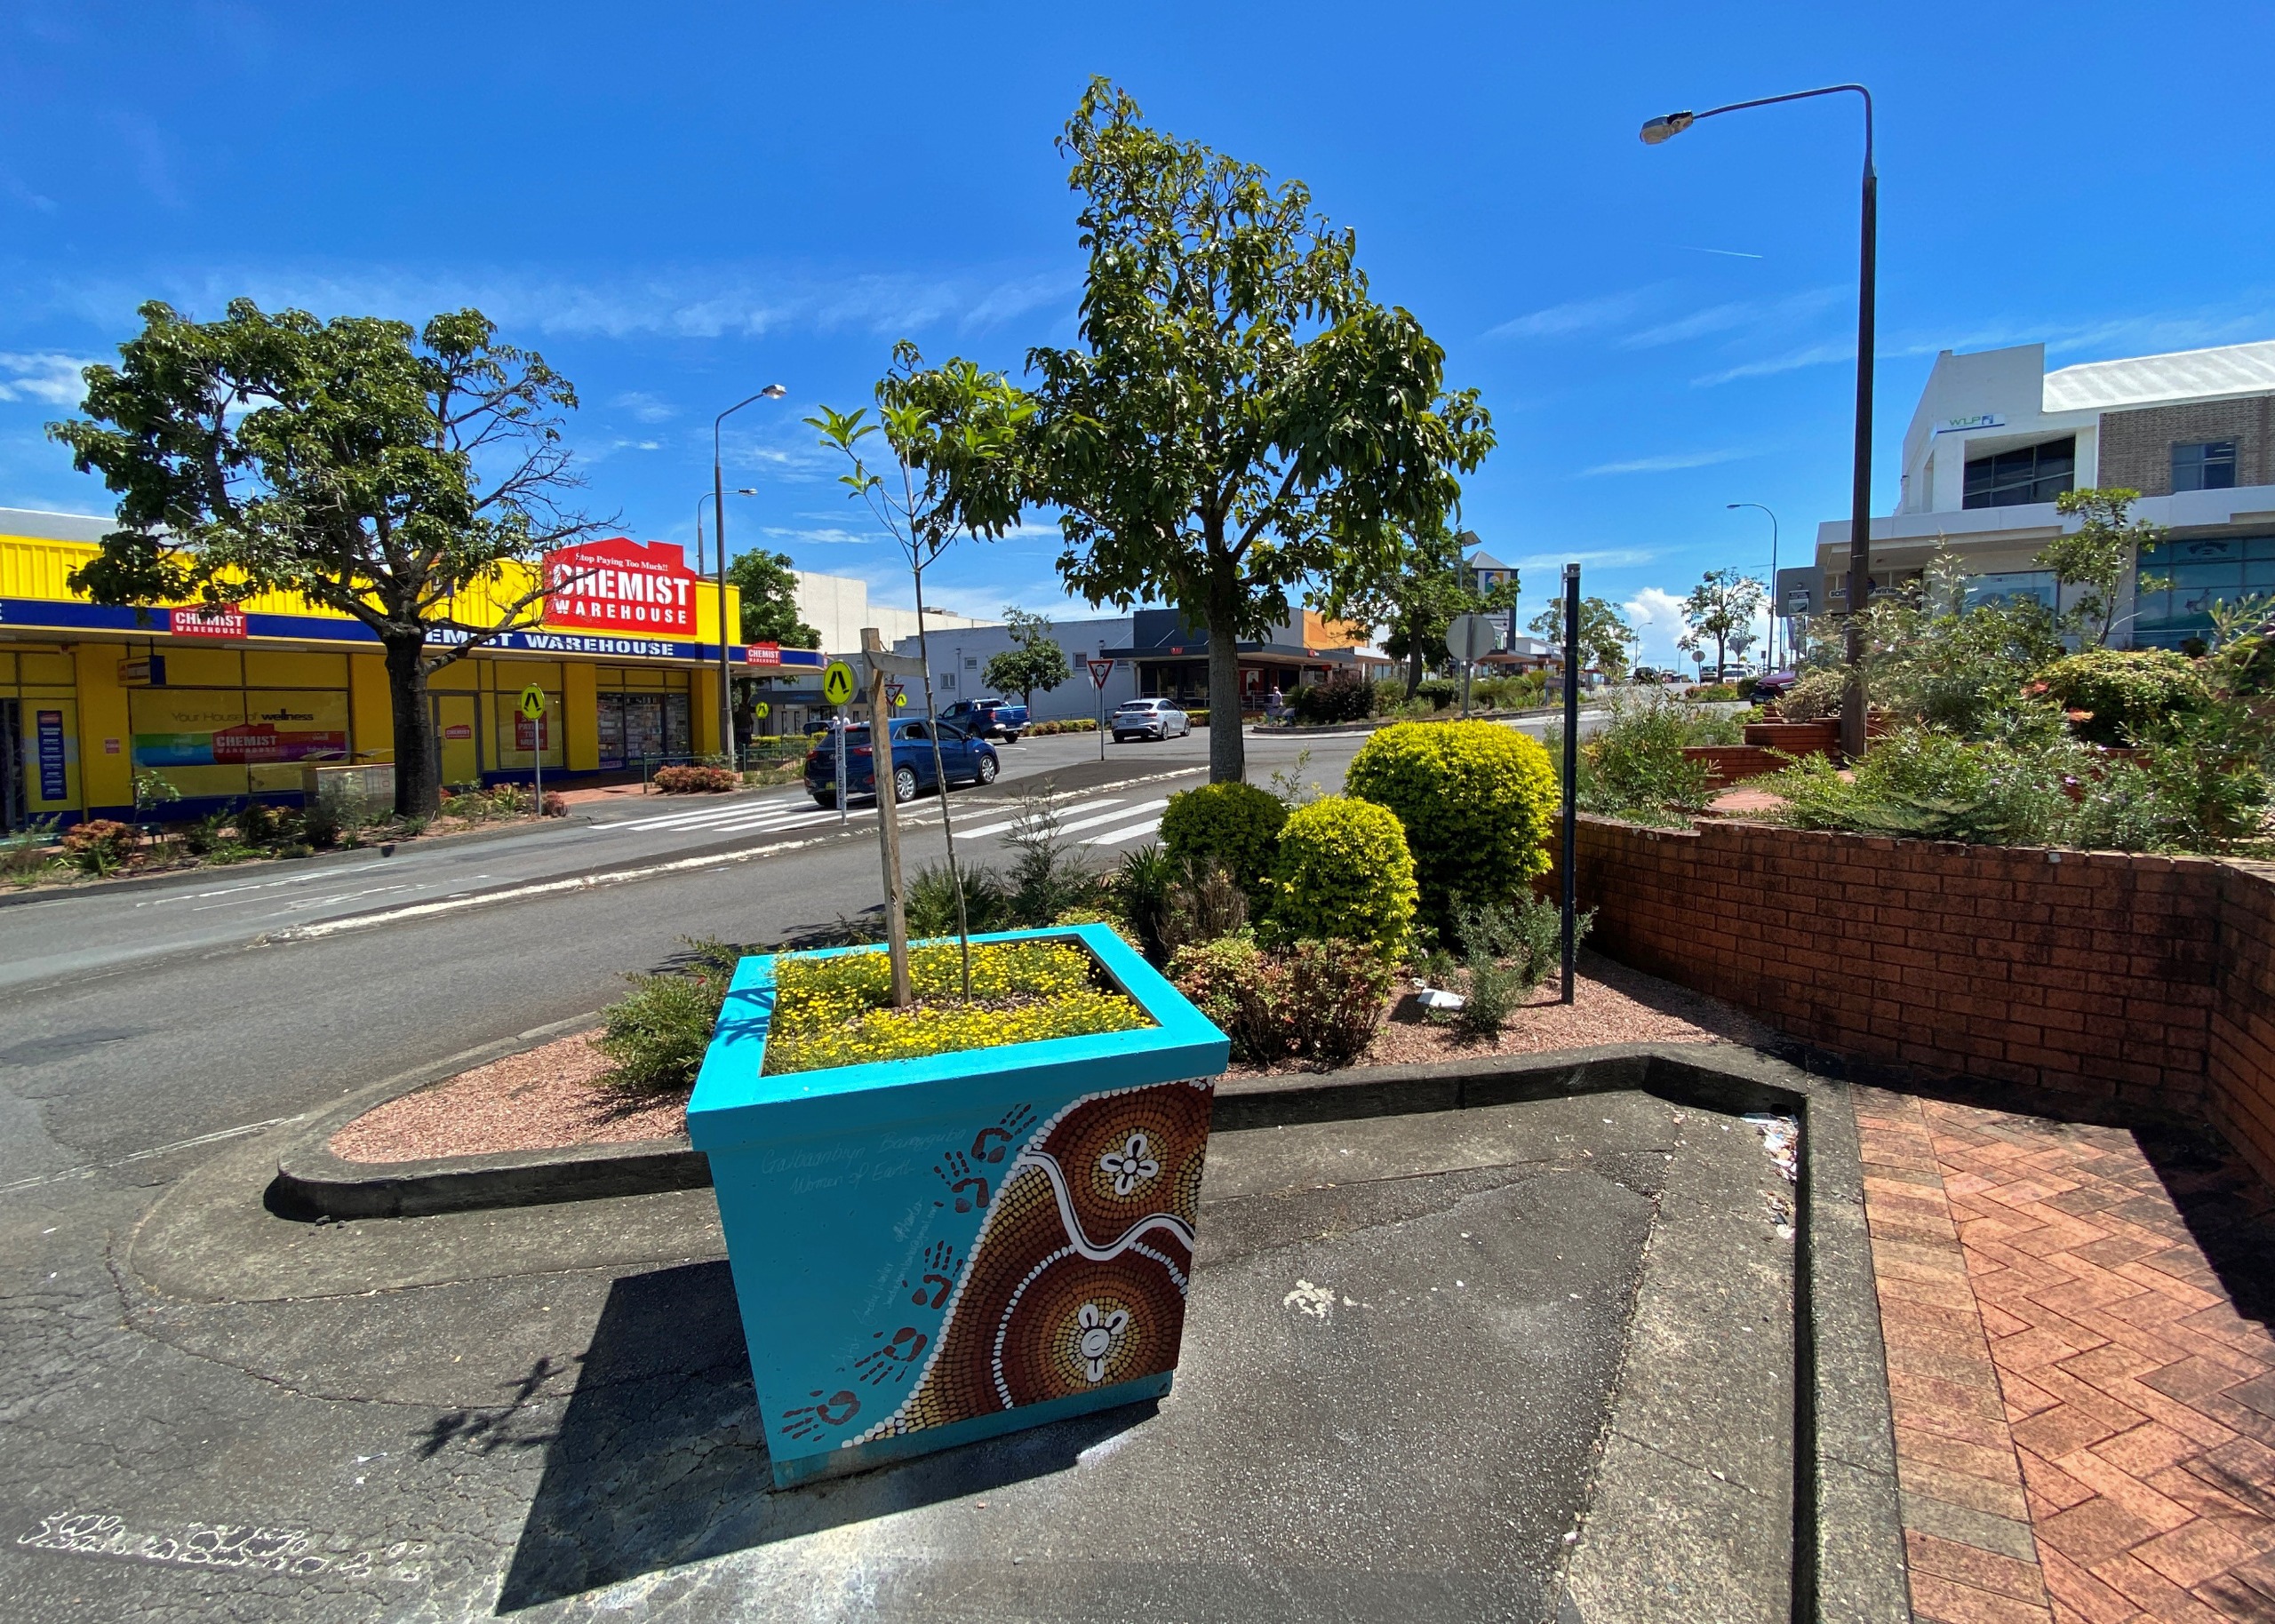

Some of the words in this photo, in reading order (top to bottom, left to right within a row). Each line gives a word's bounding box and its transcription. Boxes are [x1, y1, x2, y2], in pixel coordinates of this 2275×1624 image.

[1949, 416, 1981, 426] WLP
[575, 553, 595, 563] Stop
[596, 555, 624, 568] Paying
[625, 559, 640, 569] Too
[641, 561, 668, 571] Much!!
[553, 563, 690, 606] CHEMIST
[555, 599, 687, 625] WAREHOUSE
[176, 625, 242, 635] WAREHOUSE
[524, 633, 674, 656] WAREHOUSE
[747, 649, 779, 659] CHEMIST
[172, 712, 201, 722] Your
[204, 712, 243, 722] House
[261, 709, 314, 721] wellness
[216, 736, 277, 747] CHEMIST
[789, 1173, 844, 1195] Women
[849, 1162, 869, 1189] of
[872, 1158, 916, 1182] Earth
